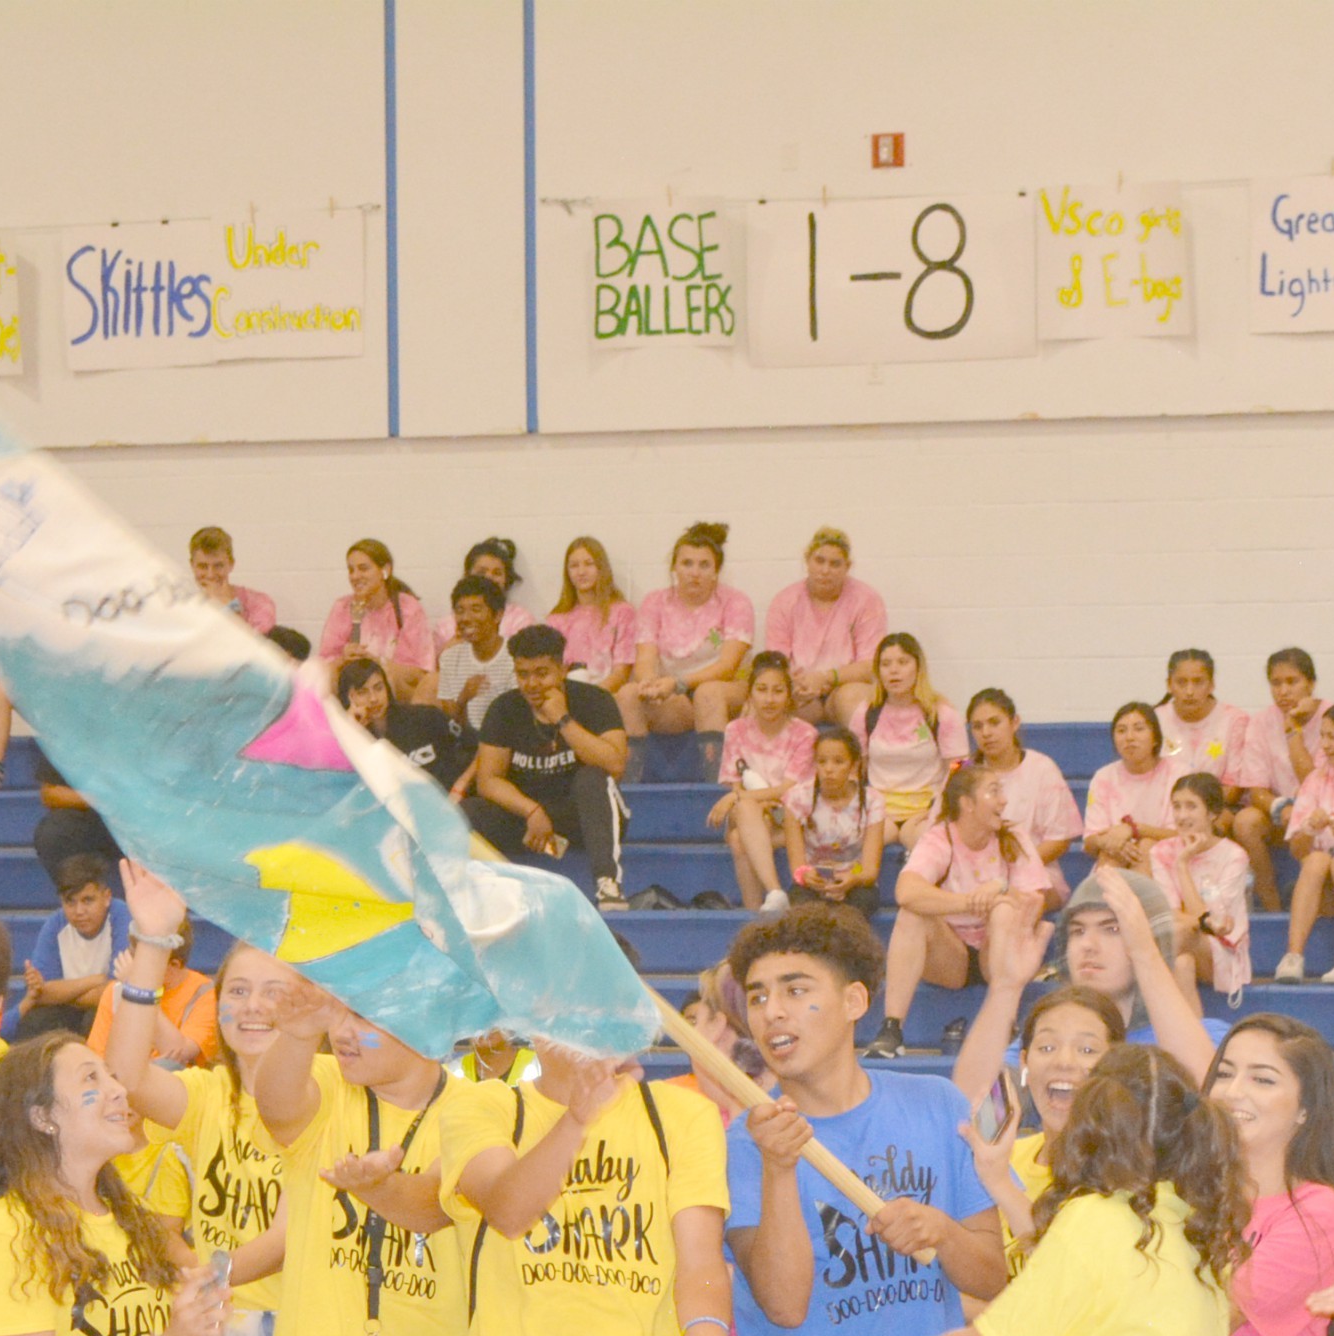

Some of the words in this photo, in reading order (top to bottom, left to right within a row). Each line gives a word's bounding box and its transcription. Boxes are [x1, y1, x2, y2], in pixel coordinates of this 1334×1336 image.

[223, 225, 320, 270] Under
[594, 211, 722, 281] BASE
[808, 203, 974, 341] 1-8
[212, 286, 361, 339] Construction
[594, 283, 736, 340] BALLERS
[512, 750, 576, 769] HOLLISTER
[198, 1134, 282, 1232] SHAR
[561, 1140, 641, 1203] aby
[851, 1144, 938, 1206] addy
